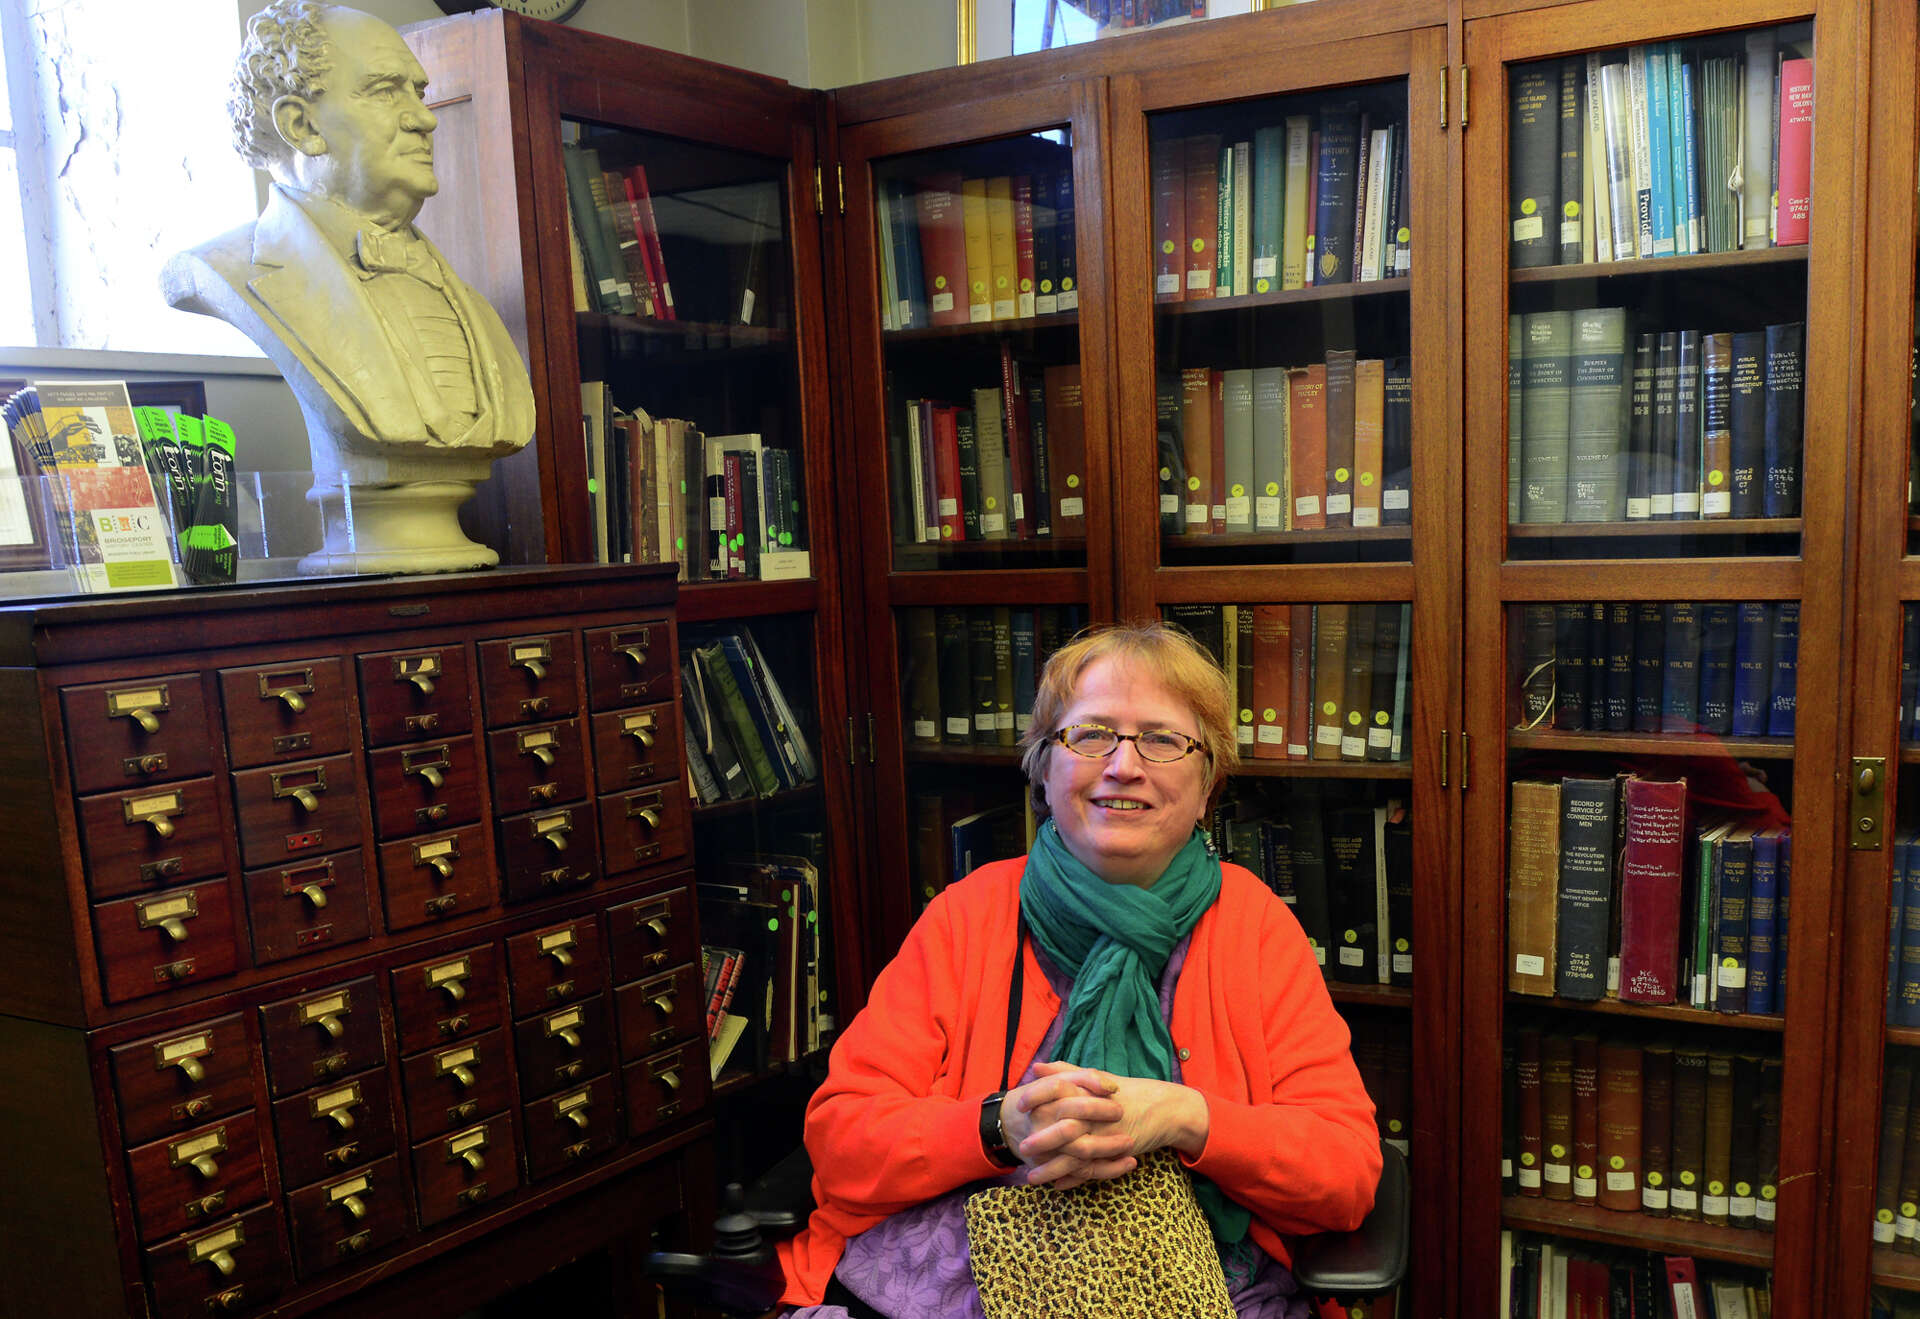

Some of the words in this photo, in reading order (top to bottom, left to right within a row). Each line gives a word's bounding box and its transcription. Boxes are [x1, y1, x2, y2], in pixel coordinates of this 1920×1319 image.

[1319, 148, 1349, 156] HISTORY
[1223, 198, 1231, 229] Western
[1787, 466, 1794, 474] 2
[104, 536, 152, 544] BRIDGEPORT
[1570, 806, 1594, 814] SERVICE
[1566, 813, 1608, 822] CONNECTICUT
[1652, 822, 1665, 830] Navy
[1627, 862, 1663, 870] Connecticut
